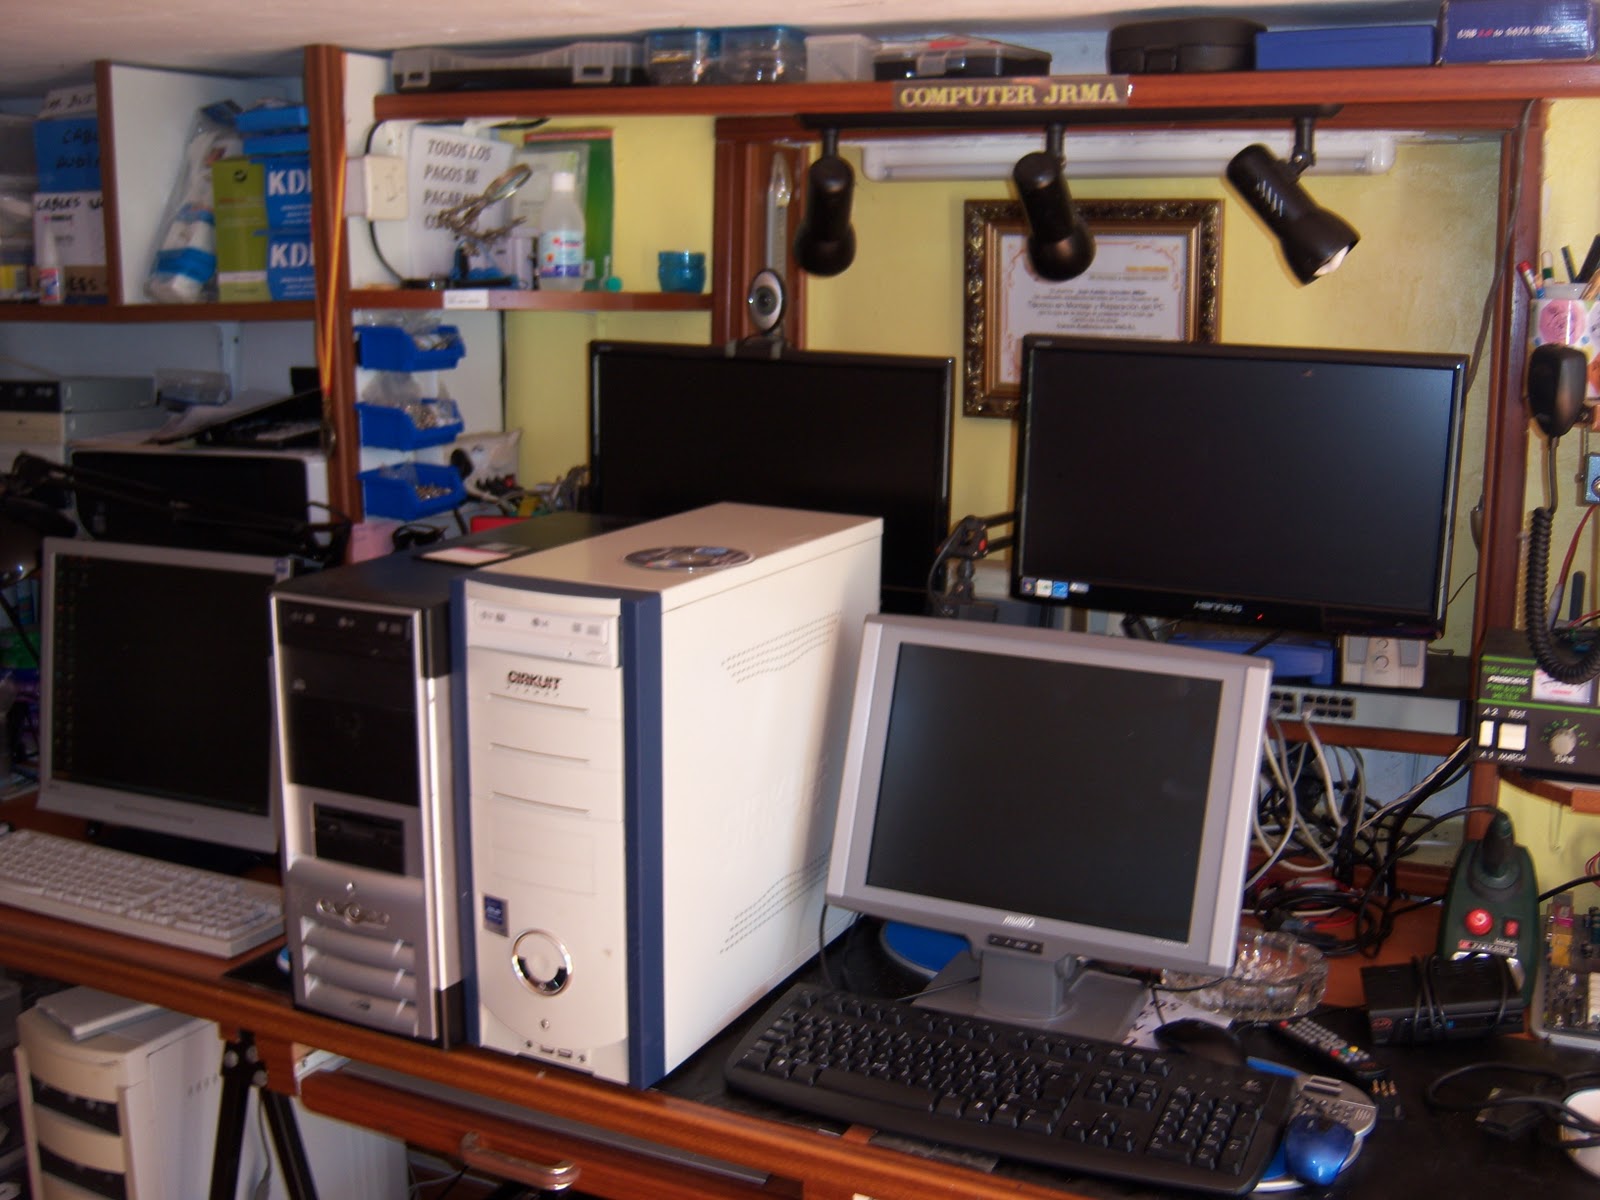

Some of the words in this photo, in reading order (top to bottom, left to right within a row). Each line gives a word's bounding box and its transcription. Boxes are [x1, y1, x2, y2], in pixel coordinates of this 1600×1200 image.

[901, 85, 1036, 107] COMPUTER
[1044, 83, 1119, 105] JRMA
[427, 139, 466, 158] TODOS
[468, 144, 493, 161] LOS
[424, 164, 464, 182] PAGOS
[465, 167, 480, 184] SE
[508, 670, 562, 690] CIRKUIT
